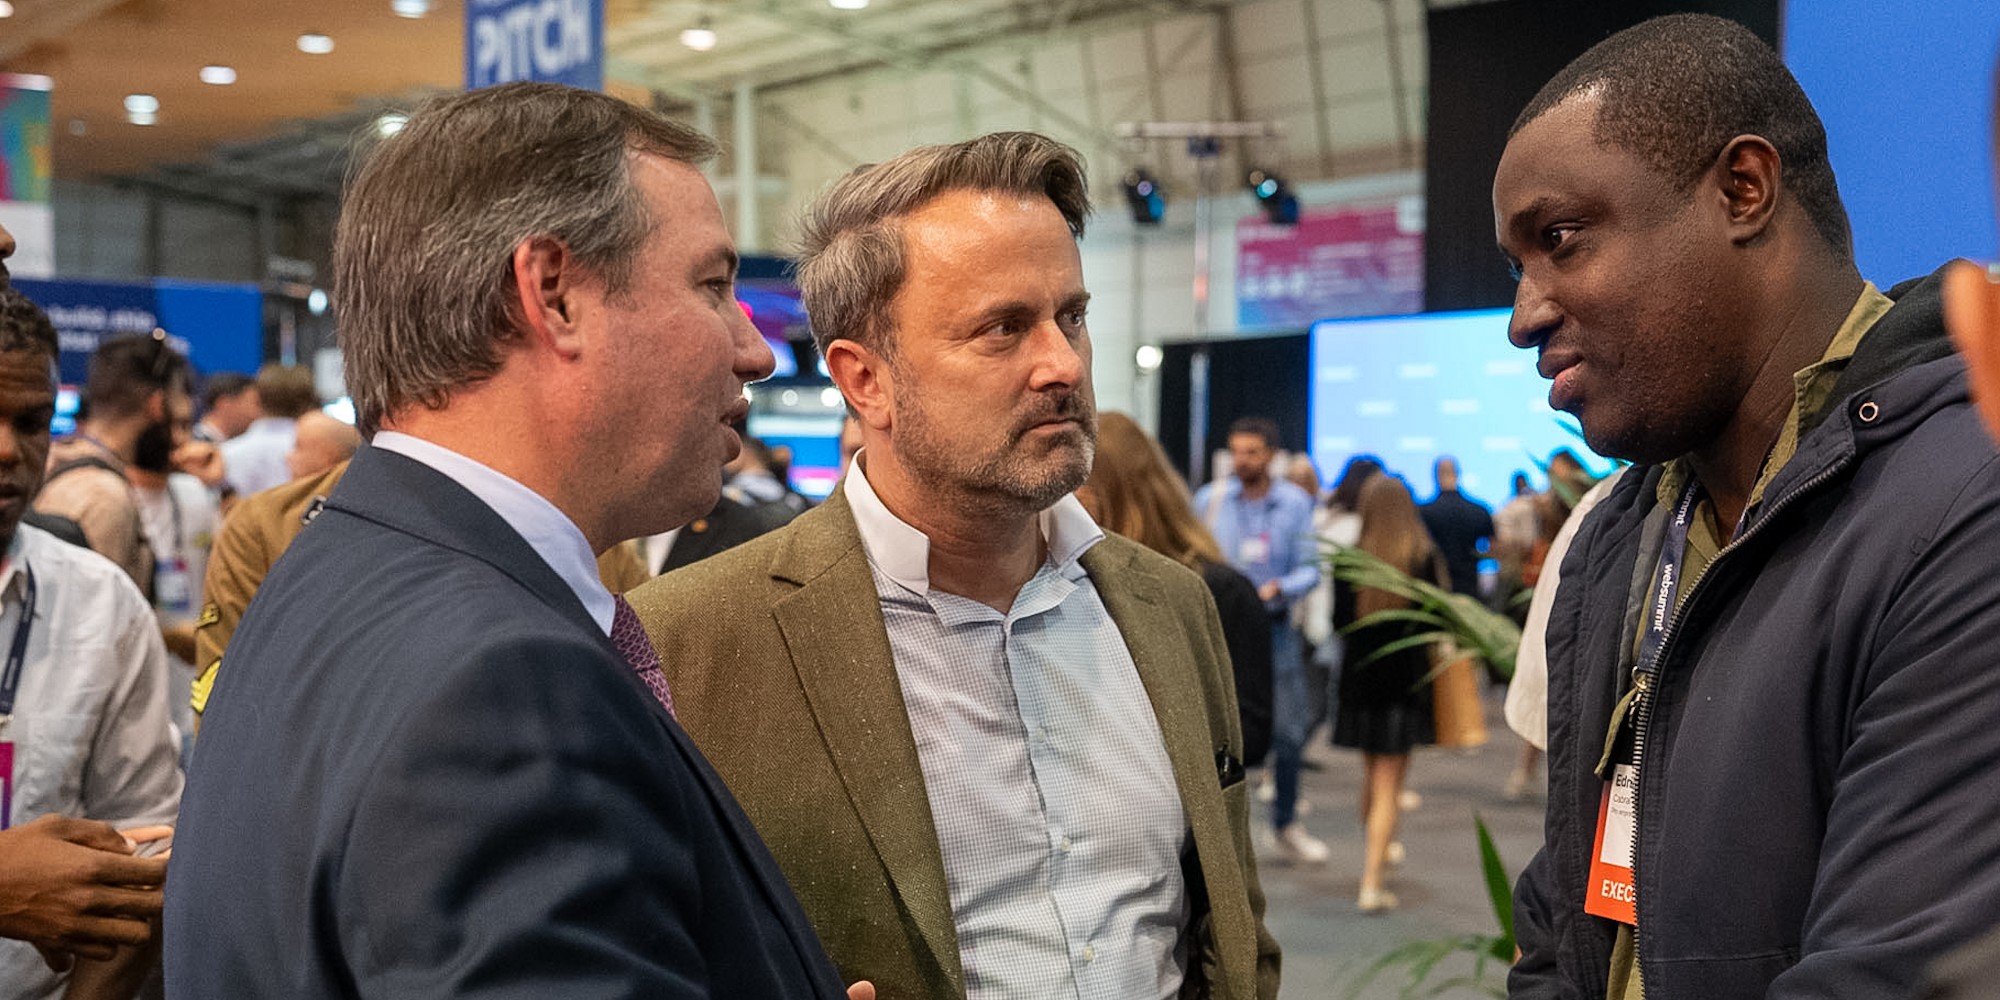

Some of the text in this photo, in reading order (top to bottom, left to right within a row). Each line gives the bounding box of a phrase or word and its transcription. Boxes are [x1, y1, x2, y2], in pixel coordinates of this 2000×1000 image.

[475, 0, 591, 82] PITCH
[1653, 563, 1673, 632] websummit
[1601, 879, 1634, 903] EXEC
